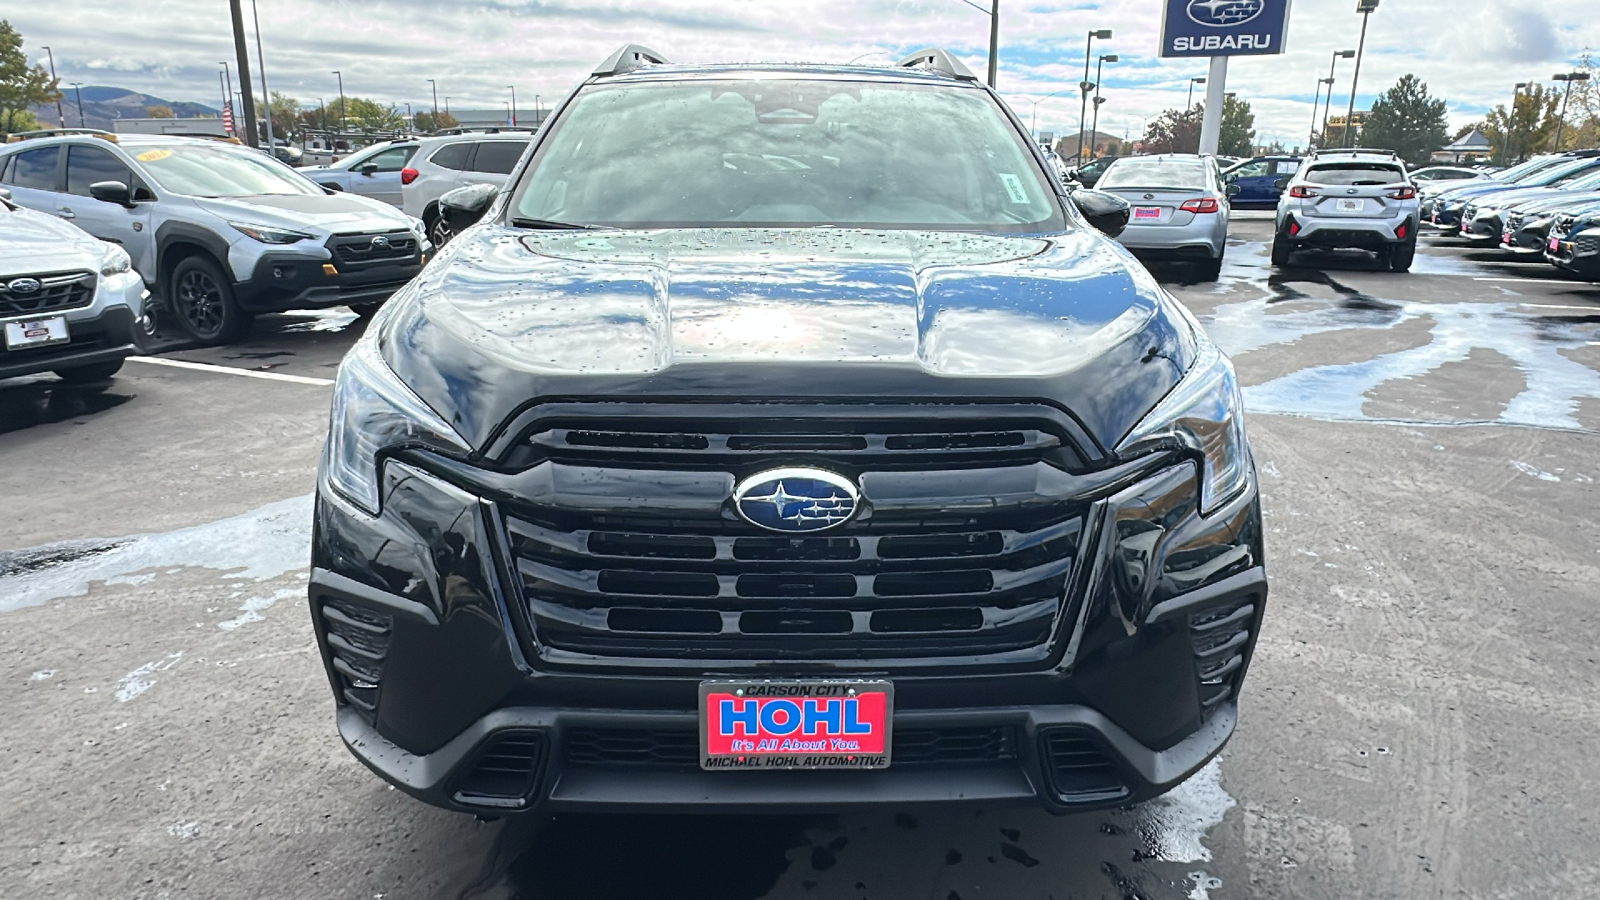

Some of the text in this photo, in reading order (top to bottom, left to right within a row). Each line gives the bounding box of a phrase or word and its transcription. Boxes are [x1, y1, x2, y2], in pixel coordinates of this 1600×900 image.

[1173, 34, 1271, 51] SUBARU
[745, 685, 850, 696] CARSON CITY
[720, 699, 872, 735] HOHL
[731, 738, 860, 751] It's All About You.
[705, 755, 886, 767] MICHAEL HOHL AUTOMOTIVE
